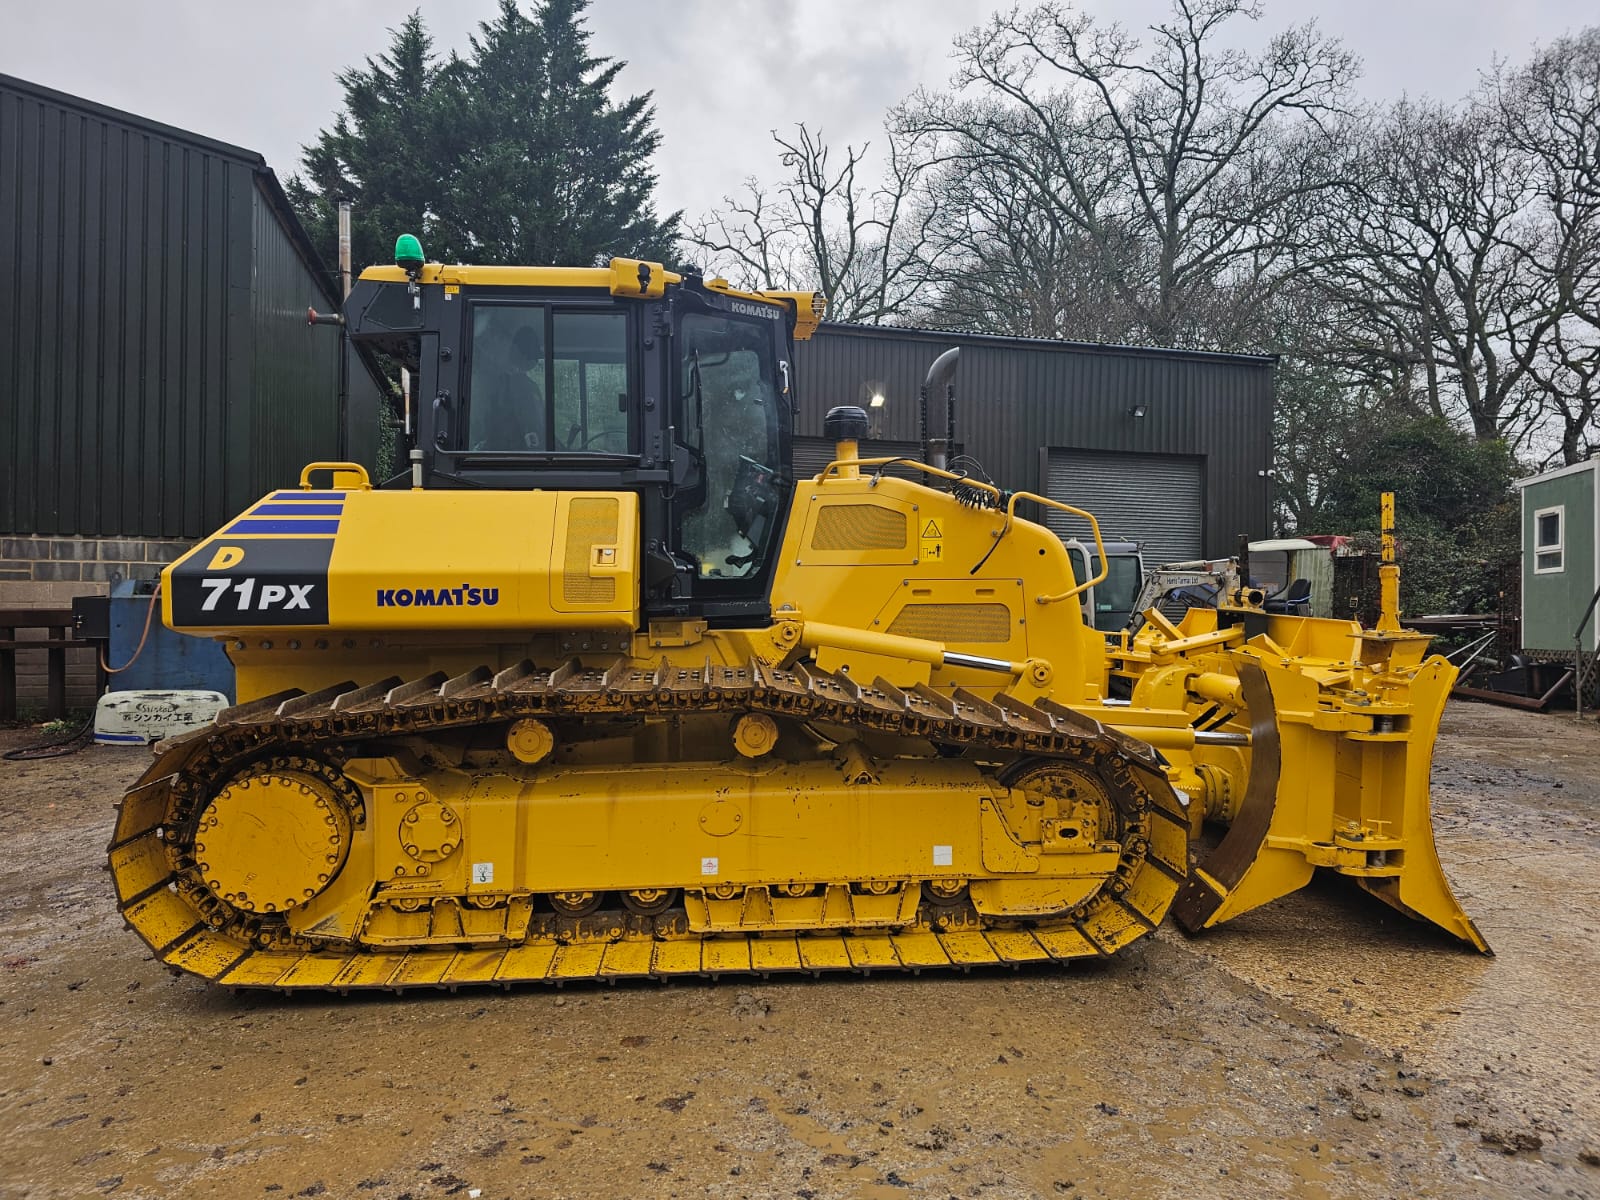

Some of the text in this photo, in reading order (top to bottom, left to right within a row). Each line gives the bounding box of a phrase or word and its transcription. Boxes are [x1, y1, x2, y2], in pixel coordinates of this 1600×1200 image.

[731, 302, 780, 320] KOMATSU
[206, 546, 245, 570] D
[376, 583, 499, 607] KOMATSU
